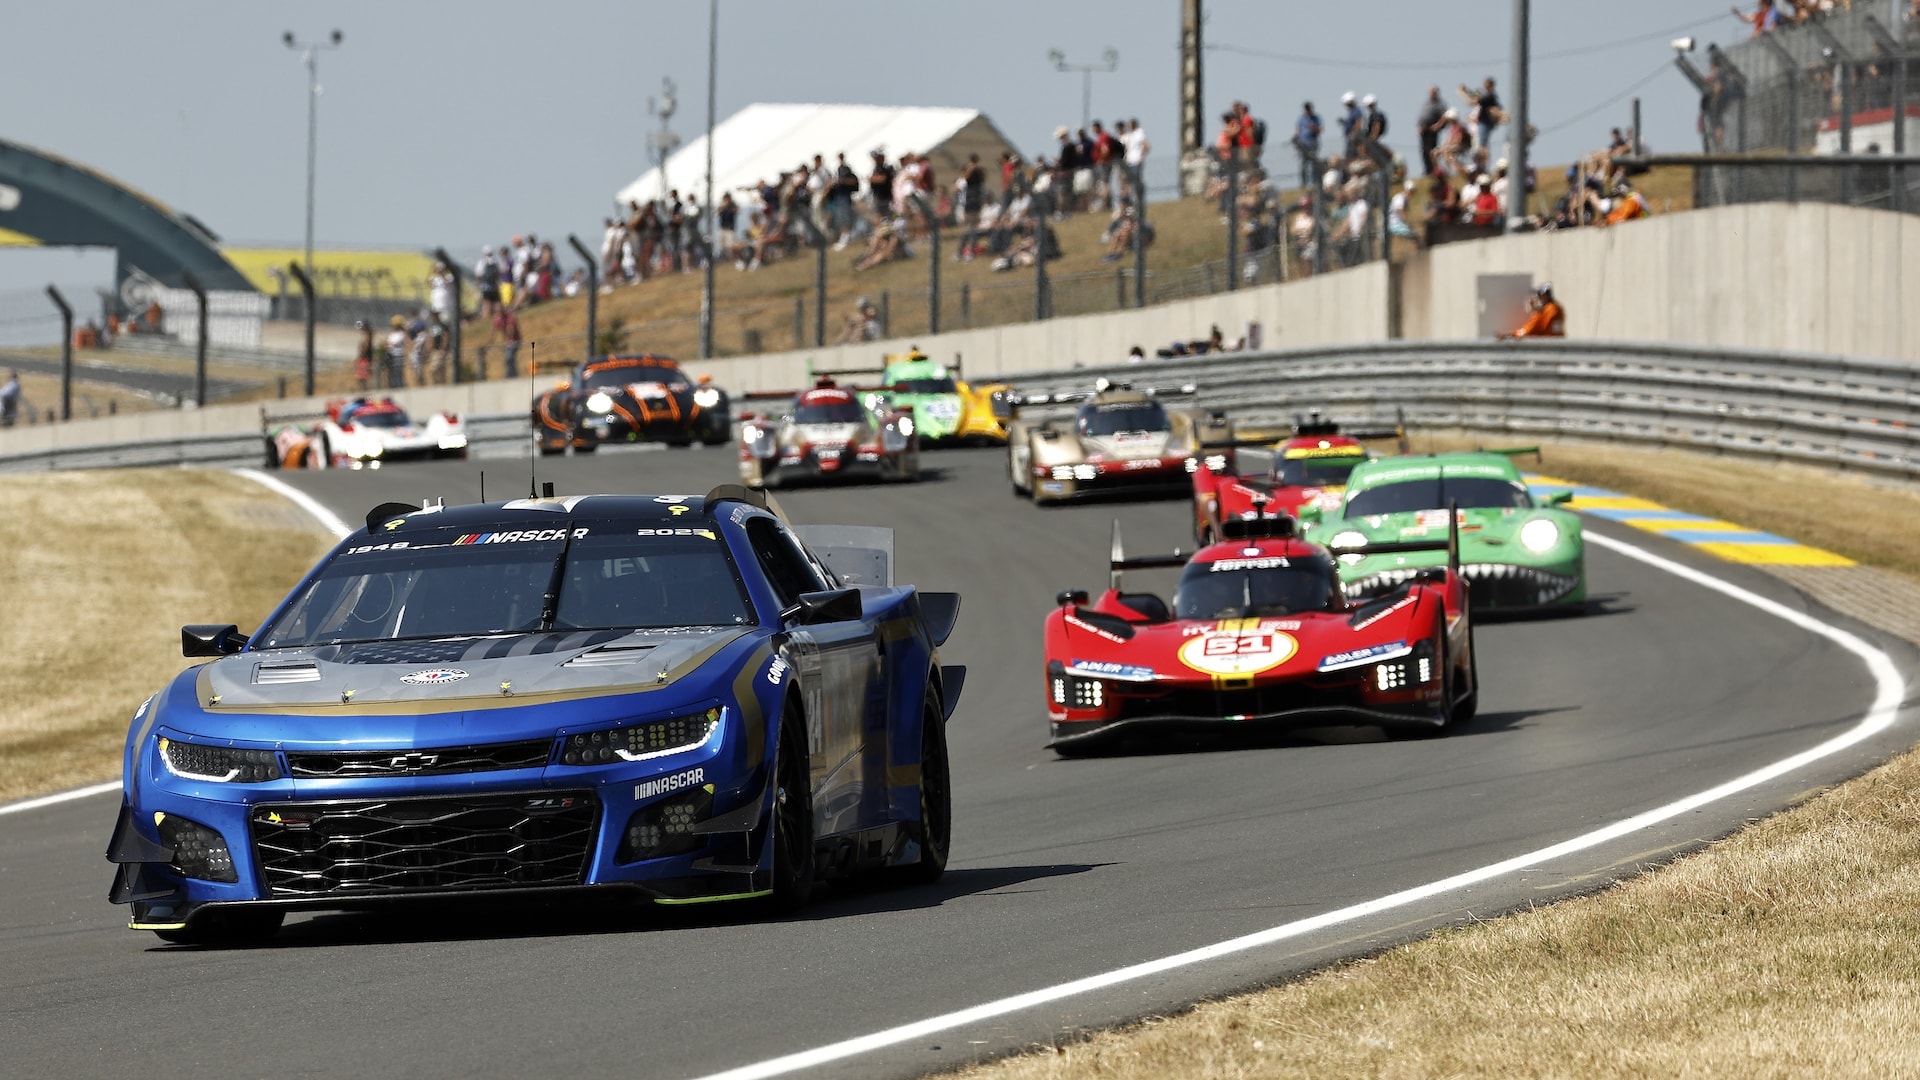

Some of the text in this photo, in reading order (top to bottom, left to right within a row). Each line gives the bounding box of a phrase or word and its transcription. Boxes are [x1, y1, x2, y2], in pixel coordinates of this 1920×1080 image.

[347, 541, 410, 555] 1948
[484, 527, 590, 544] NASCAR
[1205, 635, 1271, 655] 51
[1074, 660, 1123, 673] ADLER
[1325, 648, 1373, 667] ADLER
[651, 767, 704, 797] NASCAR
